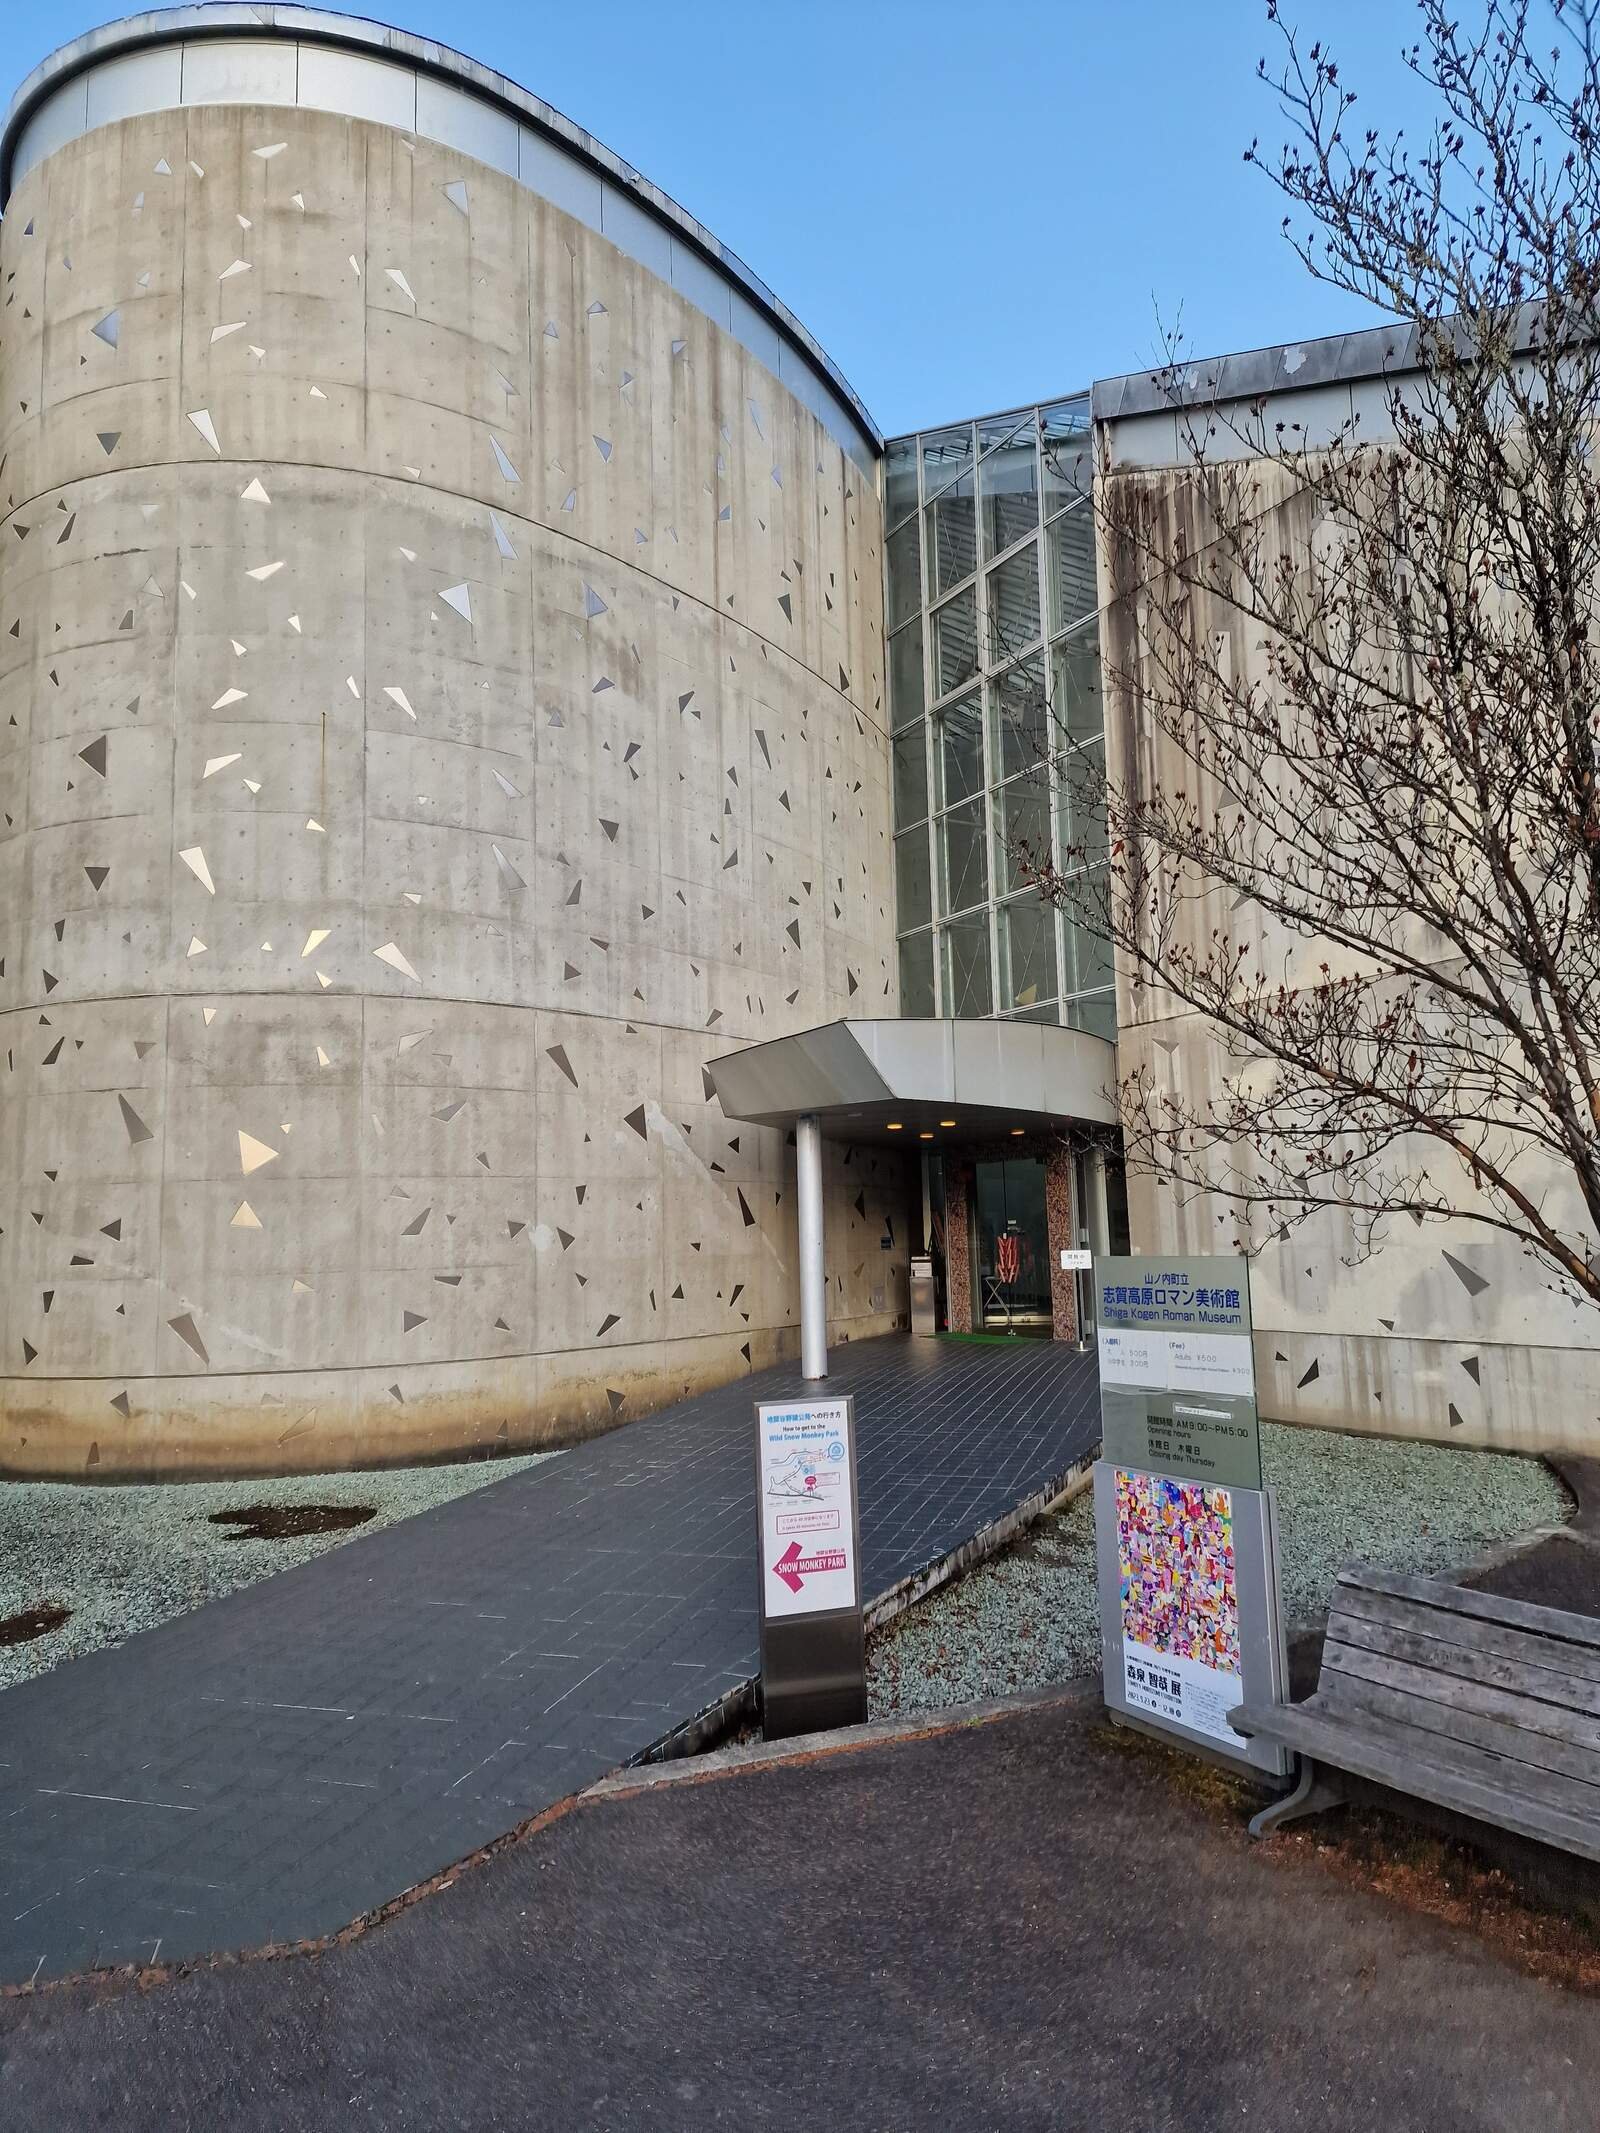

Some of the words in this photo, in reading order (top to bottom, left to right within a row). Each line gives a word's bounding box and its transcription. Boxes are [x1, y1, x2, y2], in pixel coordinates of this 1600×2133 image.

[1144, 1272, 1190, 1286] 山ノ内町立
[1103, 1286, 1240, 1309] 志賀高原ロマン美術館
[1104, 1306, 1128, 1320] Shiga
[1131, 1308, 1160, 1320] Kogen
[1162, 1310, 1195, 1322] Roman
[1199, 1311, 1242, 1324] Museum
[769, 1434, 783, 1442] Wild
[1147, 1425, 1172, 1437] Opening
[1172, 1430, 1192, 1439] hours
[1148, 1448, 1171, 1462] Closing
[1172, 1452, 1184, 1462] day
[1186, 1455, 1215, 1468] Thursday
[778, 1561, 799, 1574] SNOW
[799, 1558, 826, 1571] MONKEY
[827, 1556, 845, 1568] PARK
[1127, 1664, 1145, 1683] 森泉
[1148, 1672, 1168, 1692] 智哉
[1171, 1680, 1181, 1697] 展
